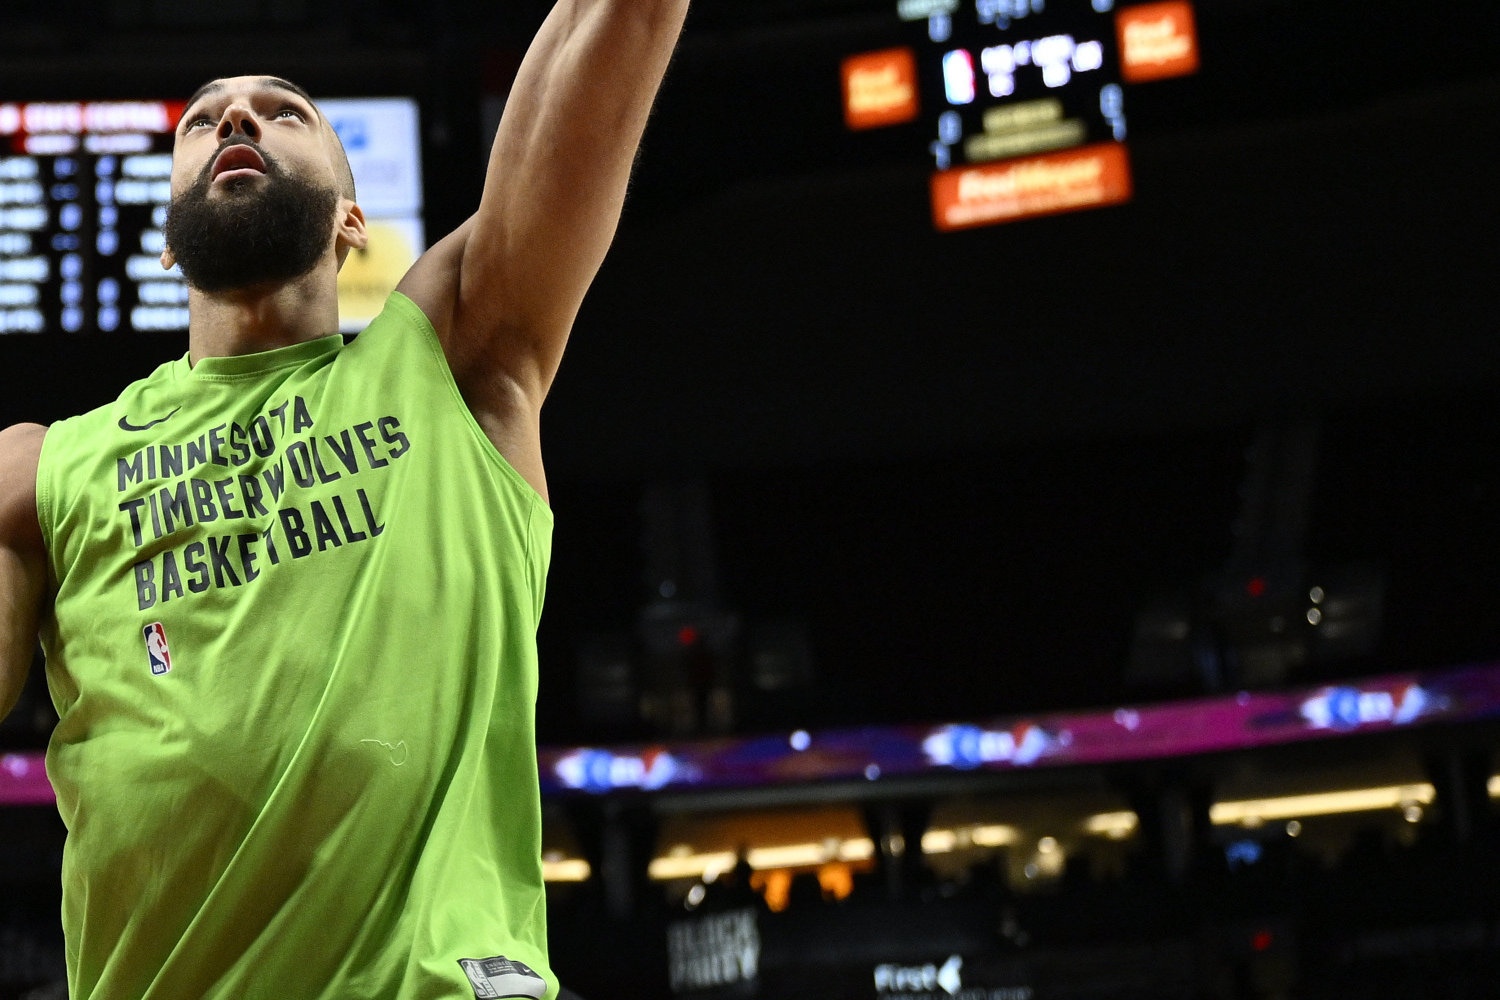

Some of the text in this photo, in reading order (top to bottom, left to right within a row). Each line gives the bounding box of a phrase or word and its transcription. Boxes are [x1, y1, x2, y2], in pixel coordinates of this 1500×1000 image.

[116, 395, 313, 491] MINNESOTA
[119, 415, 411, 546] TIMBERWOLVES
[134, 488, 386, 611] BASKETBALL
